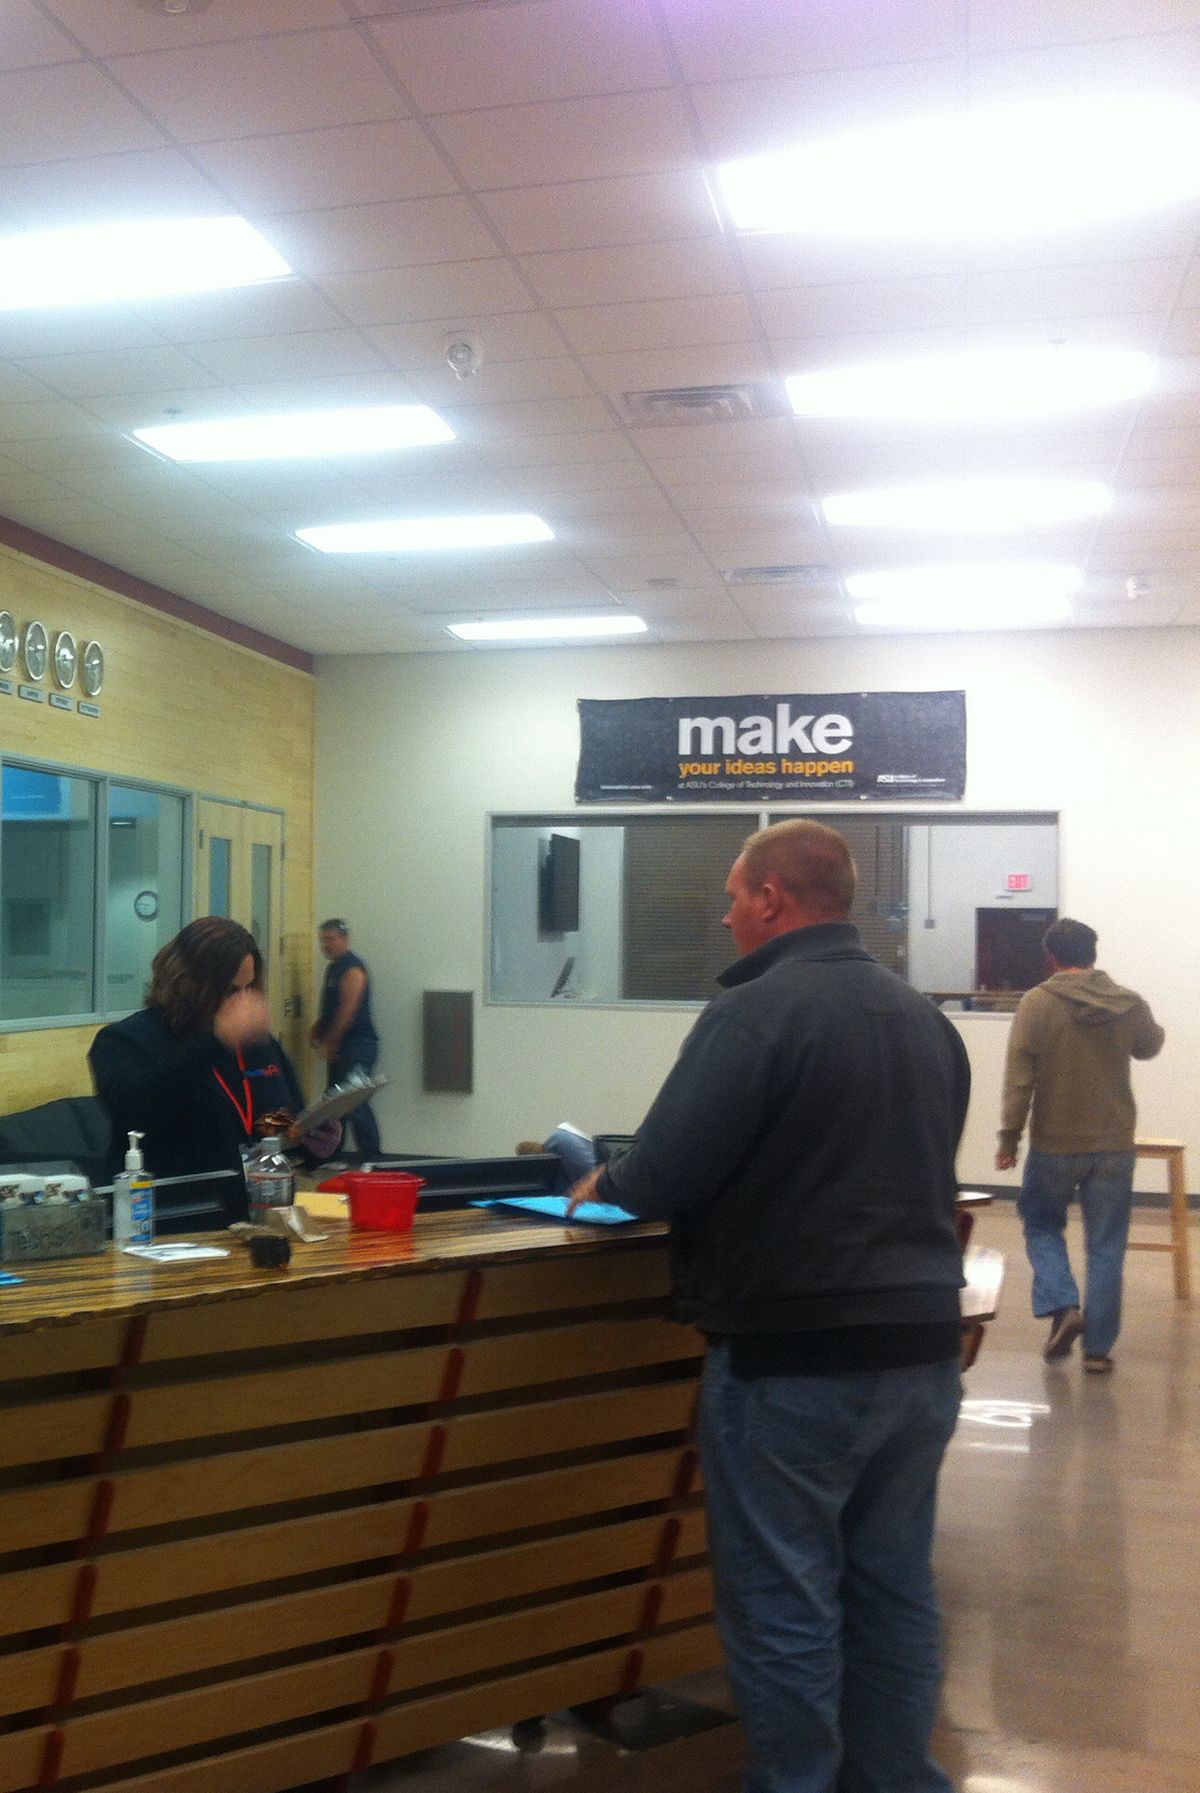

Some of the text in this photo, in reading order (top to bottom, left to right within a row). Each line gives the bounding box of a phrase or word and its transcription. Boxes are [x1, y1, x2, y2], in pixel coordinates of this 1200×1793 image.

[678, 703, 854, 756] make
[678, 757, 855, 778] your ideas happen
